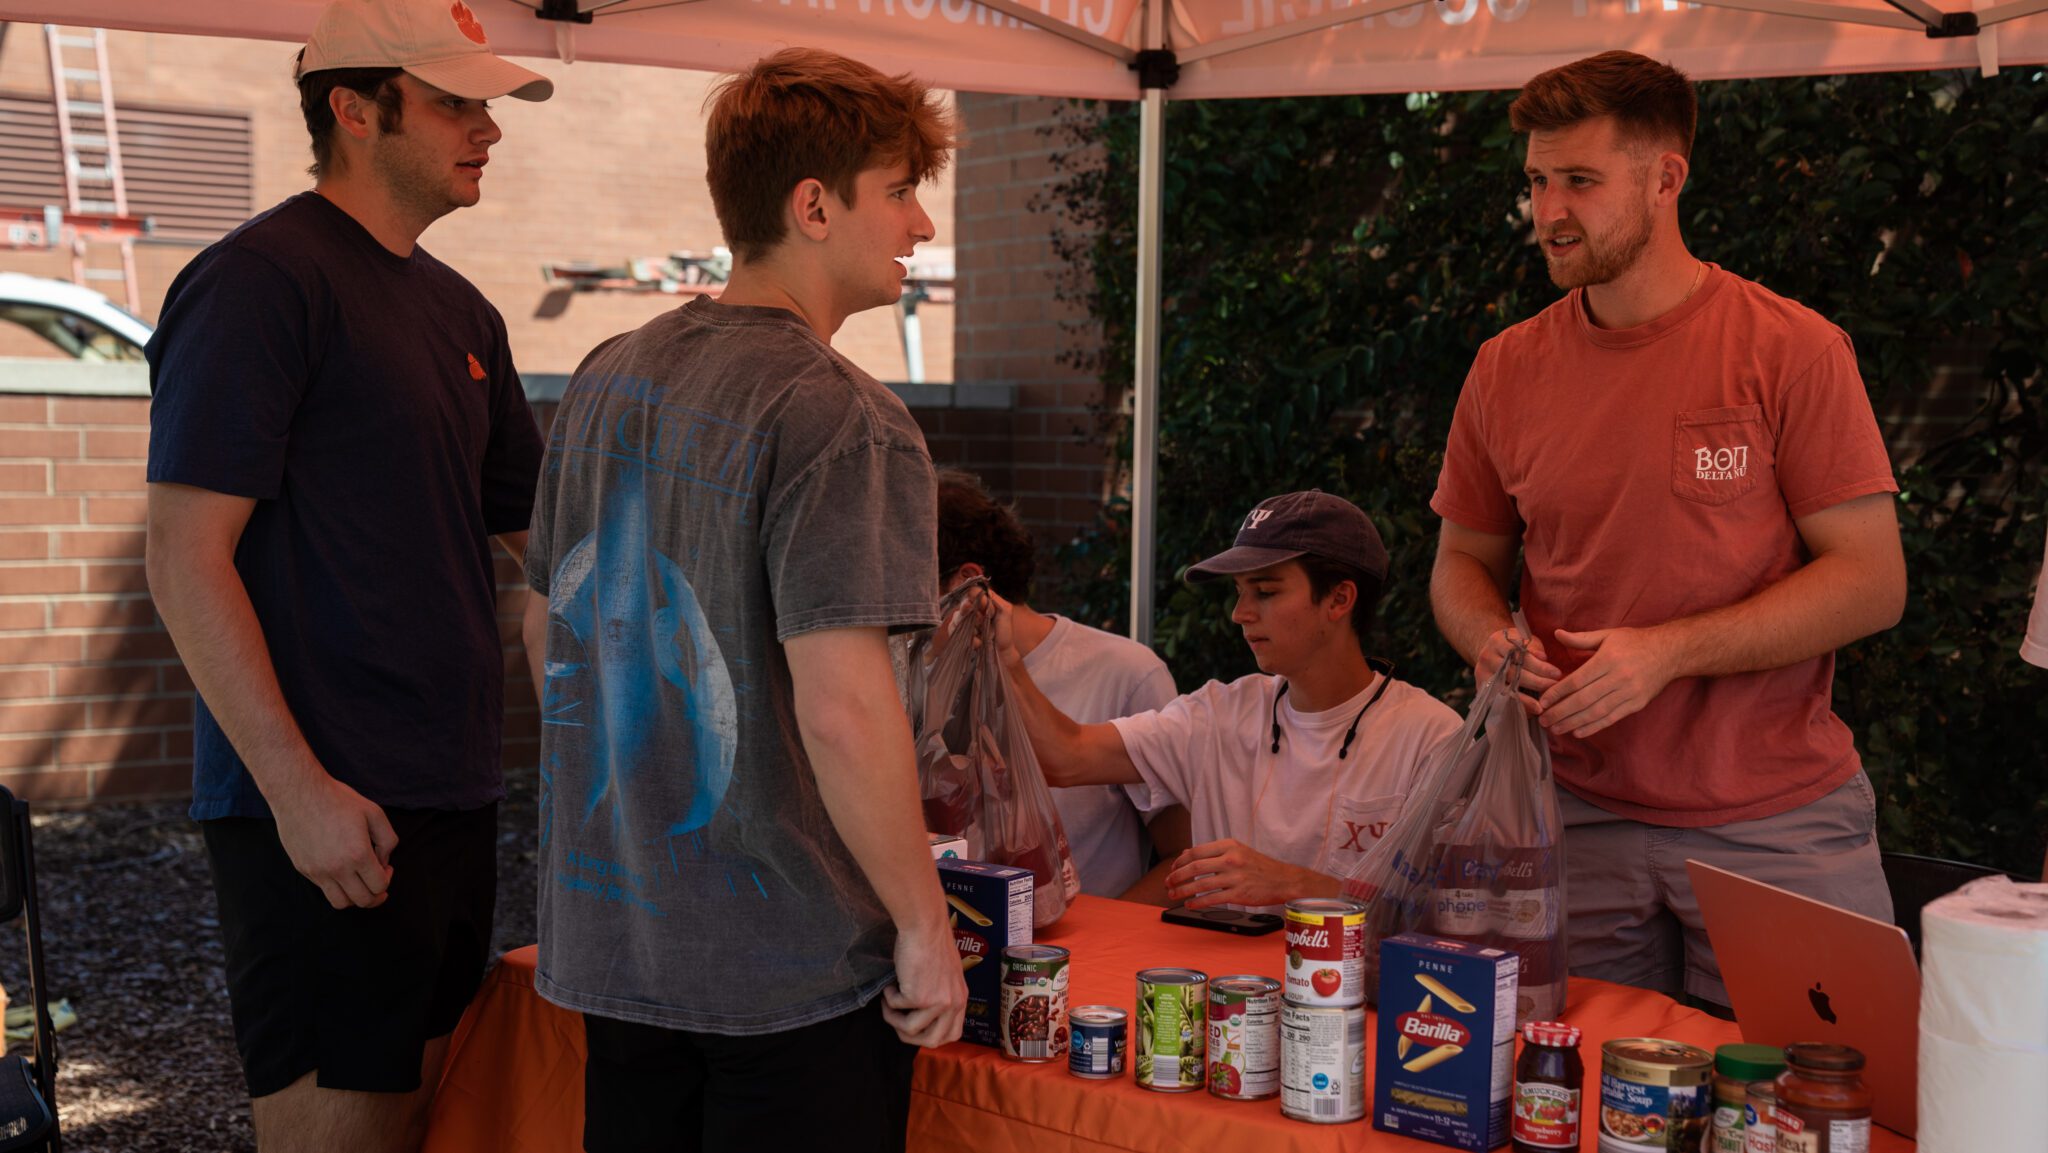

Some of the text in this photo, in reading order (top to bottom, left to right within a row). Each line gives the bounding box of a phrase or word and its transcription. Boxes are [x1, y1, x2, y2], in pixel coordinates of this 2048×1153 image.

[1696, 467, 1747, 480] DELTA NU
[946, 881, 975, 893] PENNE
[1438, 898, 1486, 915] phone
[956, 936, 982, 953] rilla
[1286, 929, 1329, 947] mpbell's
[1012, 963, 1037, 972] ORGANIC
[1418, 960, 1453, 974] PENNE
[1210, 994, 1227, 1004] GANIC
[1292, 1011, 1310, 1021] Facts
[1403, 1016, 1461, 1042] Barilla
[1610, 1075, 1646, 1096] Harvest
[1627, 1093, 1654, 1108] Soup
[1777, 1133, 1808, 1153] Meat
